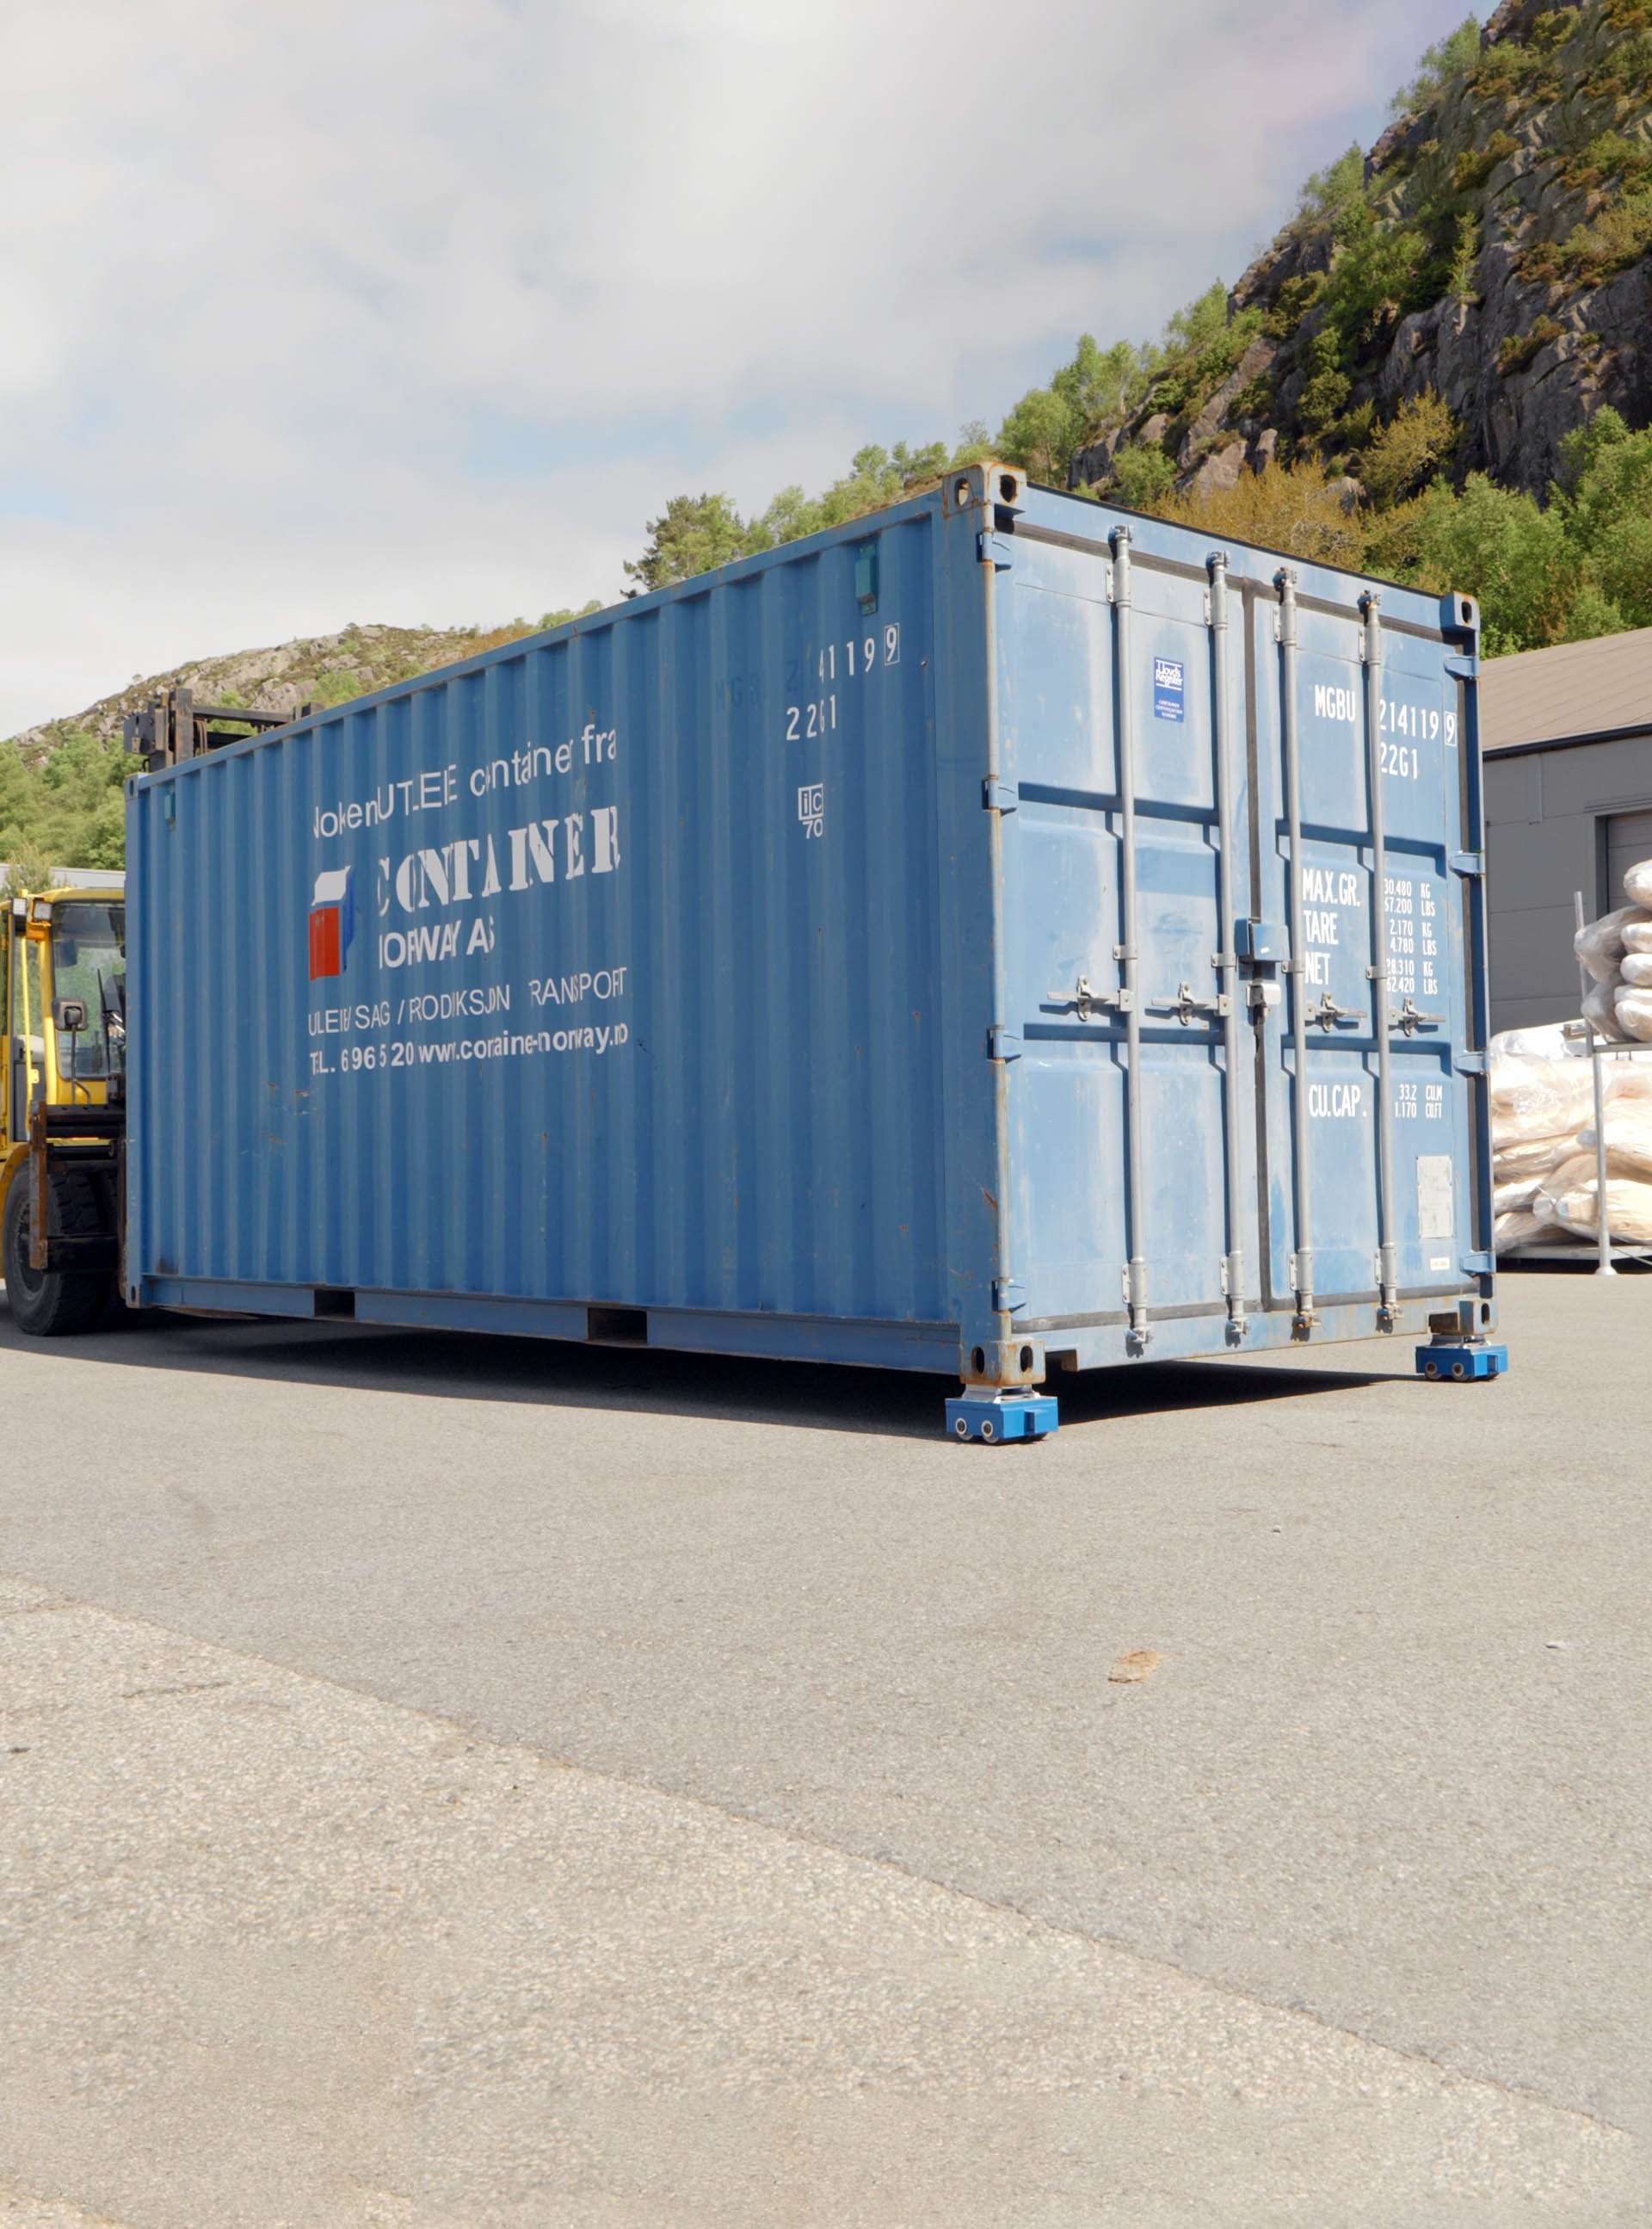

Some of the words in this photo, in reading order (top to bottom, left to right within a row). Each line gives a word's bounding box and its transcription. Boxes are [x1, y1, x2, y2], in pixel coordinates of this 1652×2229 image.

[1315, 685, 1356, 722] MGBU
[1379, 699, 1439, 740] 214119
[1381, 742, 1418, 779] 22G1
[803, 818, 823, 839] 70
[1303, 868, 1360, 906] MAX.GR.
[1384, 879, 1412, 897] 30.480
[1421, 883, 1431, 899] KG
[1421, 900, 1436, 917] LBS
[1304, 910, 1339, 945] TARE
[1390, 918, 1413, 937] 2.170
[1422, 922, 1433, 938] KG
[1390, 936, 1415, 954] 4.780
[1423, 939, 1437, 956] LBS
[1304, 951, 1330, 985] NET
[1423, 960, 1433, 978] KG
[1386, 976, 1415, 994] 62.420
[1424, 979, 1438, 995] LBS
[1399, 1084, 1417, 1102] 33.2
[1395, 1102, 1417, 1118] 1.170
